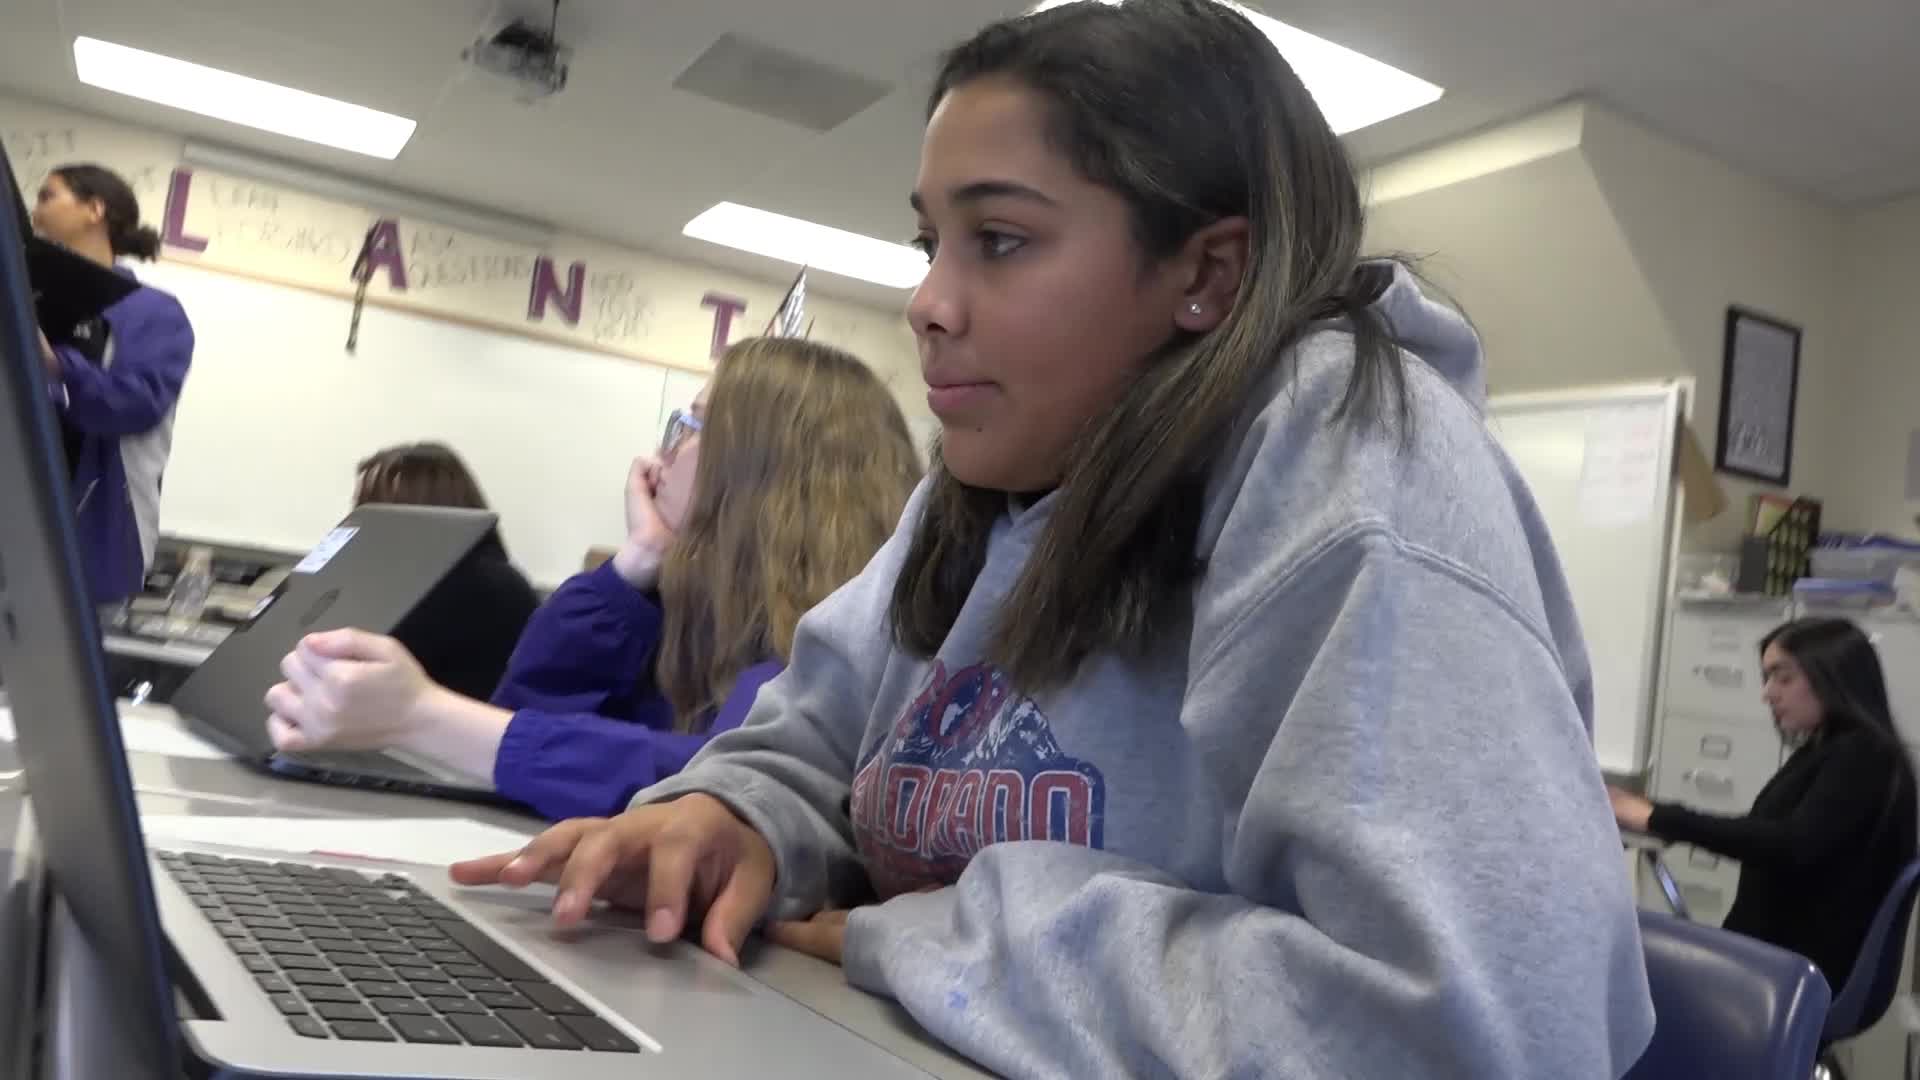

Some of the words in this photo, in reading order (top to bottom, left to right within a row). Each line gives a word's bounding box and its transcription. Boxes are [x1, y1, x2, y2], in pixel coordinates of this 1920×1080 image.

[161, 168, 208, 252] L
[358, 217, 407, 290] A
[527, 255, 585, 327] N
[701, 292, 747, 361] T
